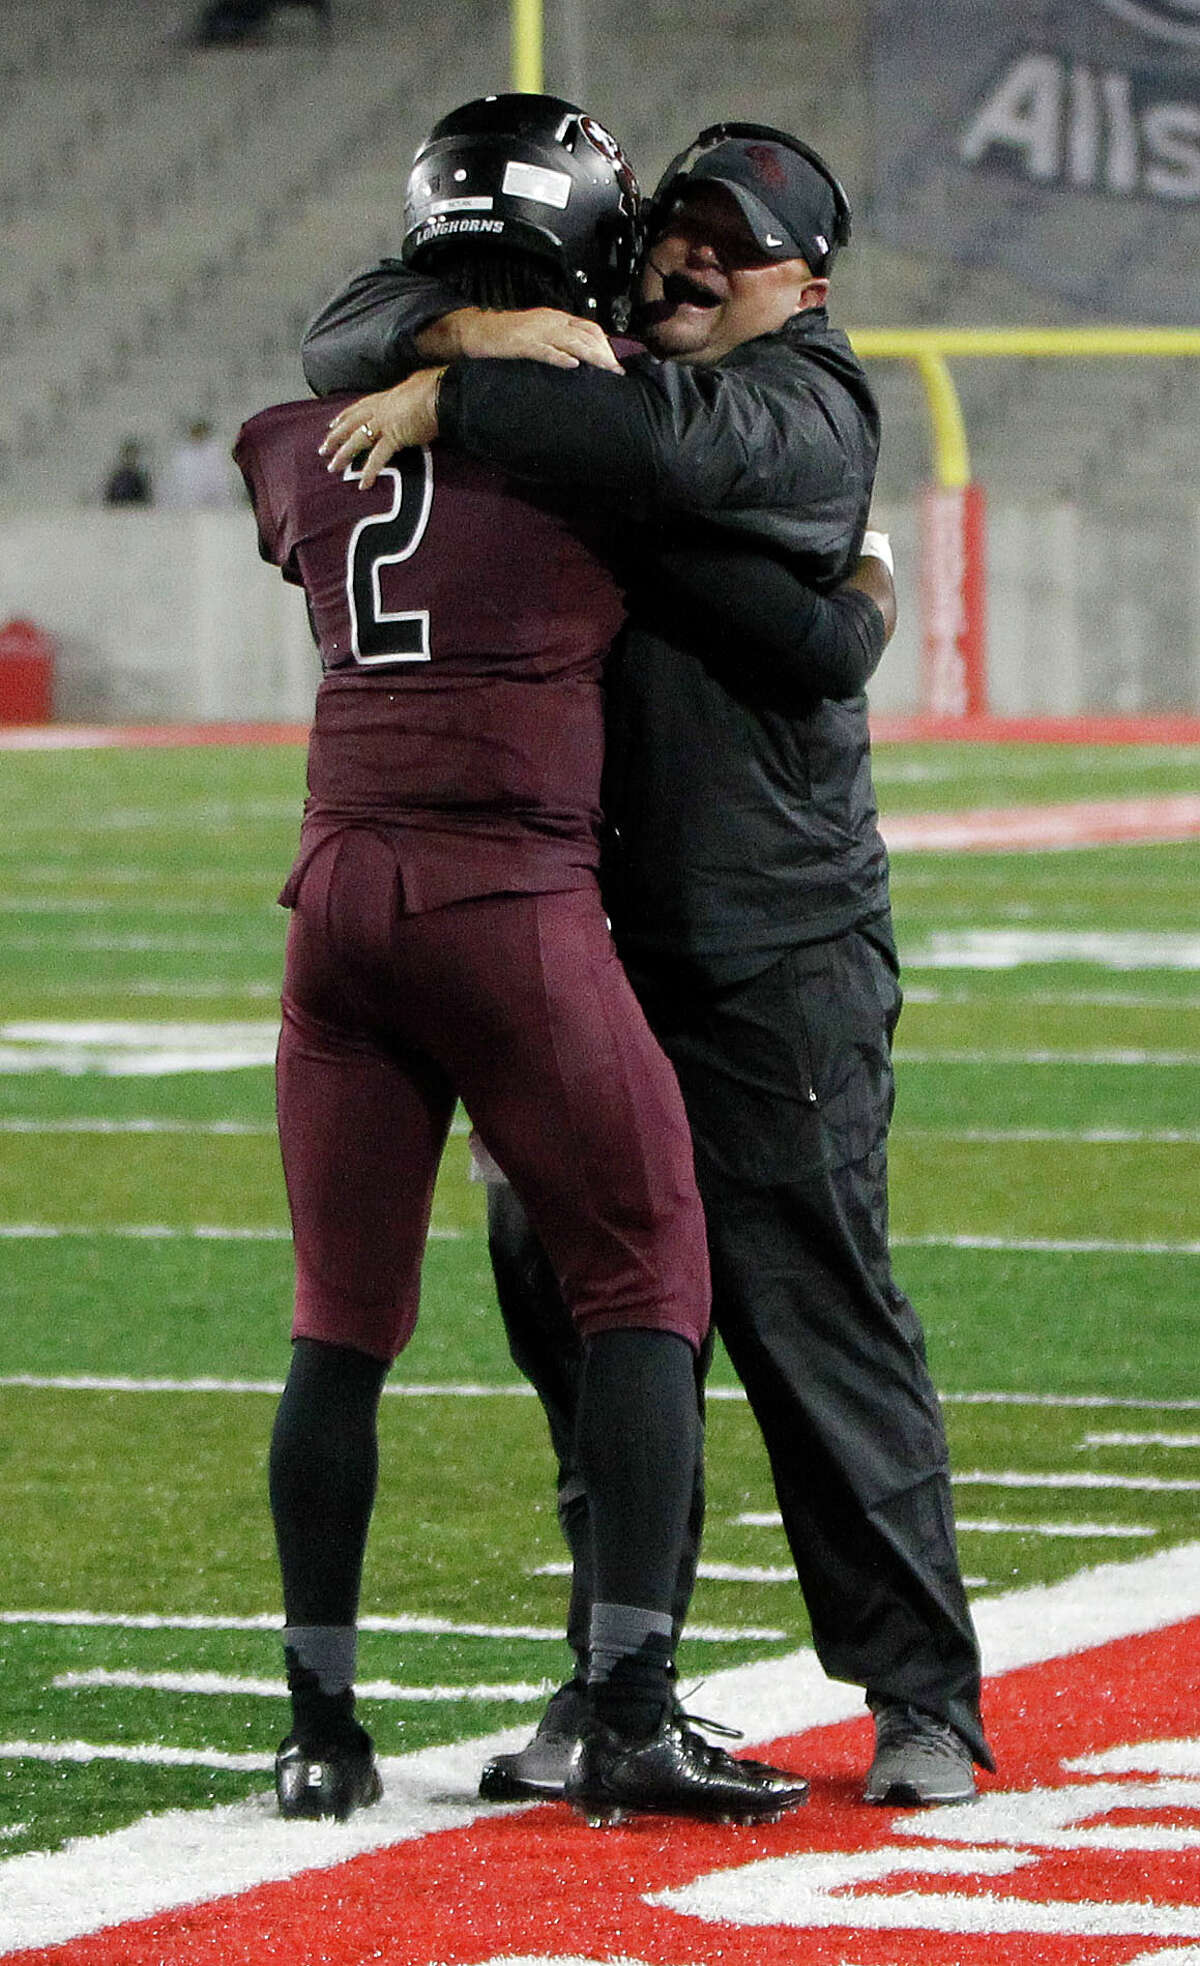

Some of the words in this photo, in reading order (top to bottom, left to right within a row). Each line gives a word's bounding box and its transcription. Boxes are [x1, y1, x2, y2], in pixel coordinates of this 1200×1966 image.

[415, 219, 505, 246] LONGHORNS
[343, 442, 434, 664] 2
[308, 1764, 324, 1787] 2
